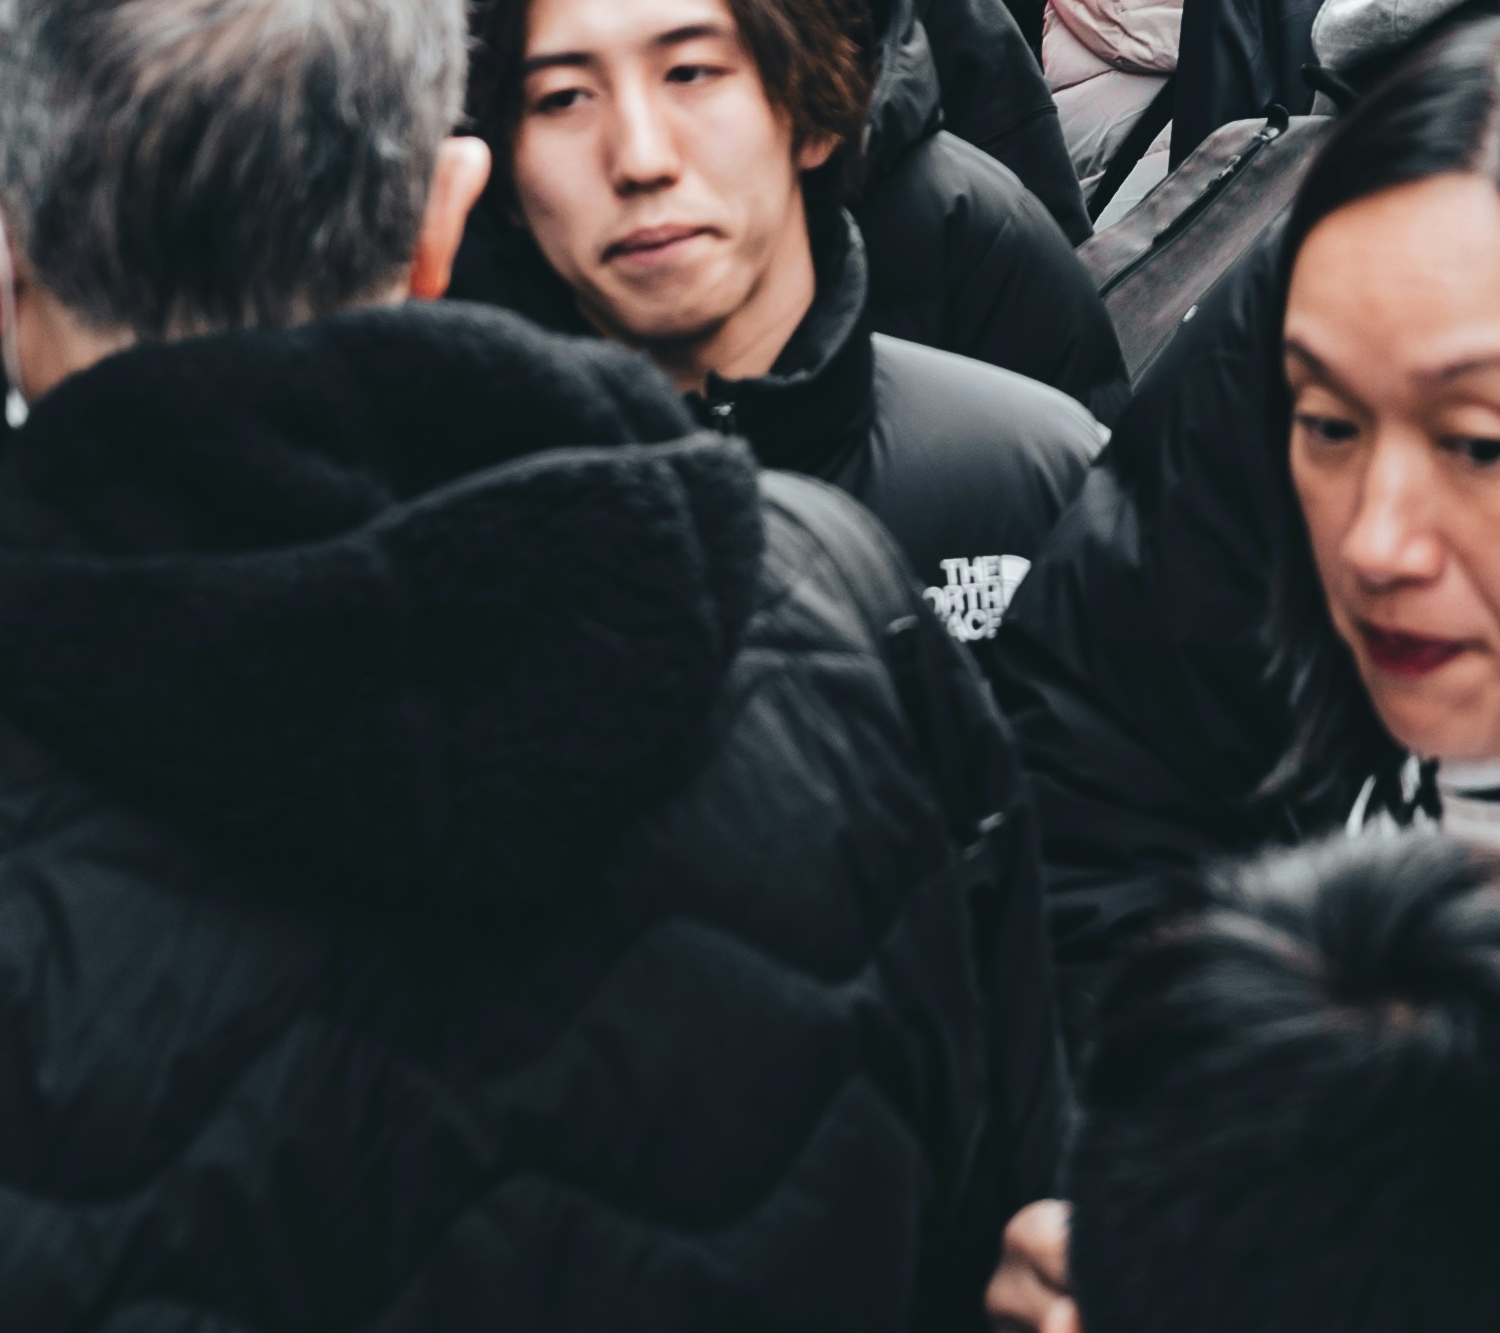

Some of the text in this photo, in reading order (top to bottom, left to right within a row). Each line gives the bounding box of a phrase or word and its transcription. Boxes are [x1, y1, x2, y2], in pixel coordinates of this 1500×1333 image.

[939, 554, 1000, 585] THE
[921, 579, 1003, 621] ORTH
[946, 607, 1002, 643] ACE
